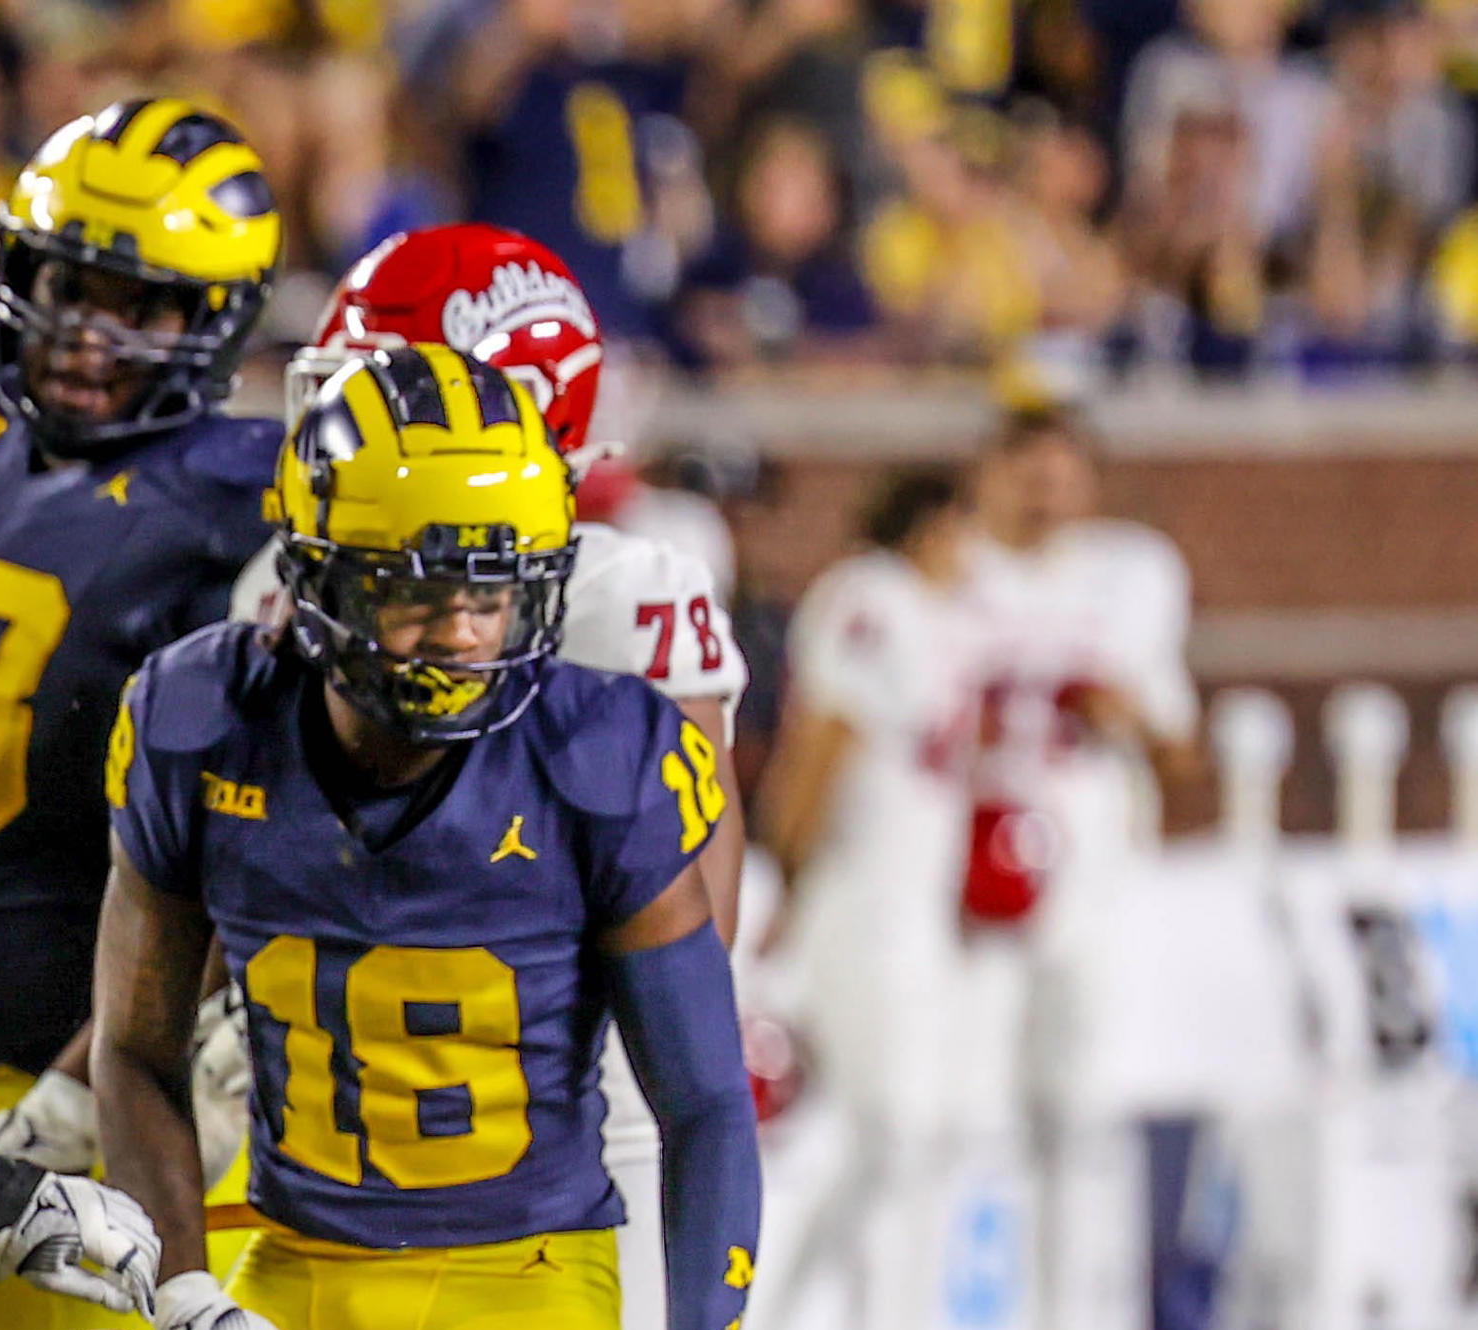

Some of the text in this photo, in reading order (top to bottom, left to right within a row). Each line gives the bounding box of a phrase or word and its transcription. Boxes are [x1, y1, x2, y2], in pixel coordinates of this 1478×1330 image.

[635, 595, 723, 680] 78
[660, 719, 727, 855] 18
[246, 934, 534, 1190] 18
